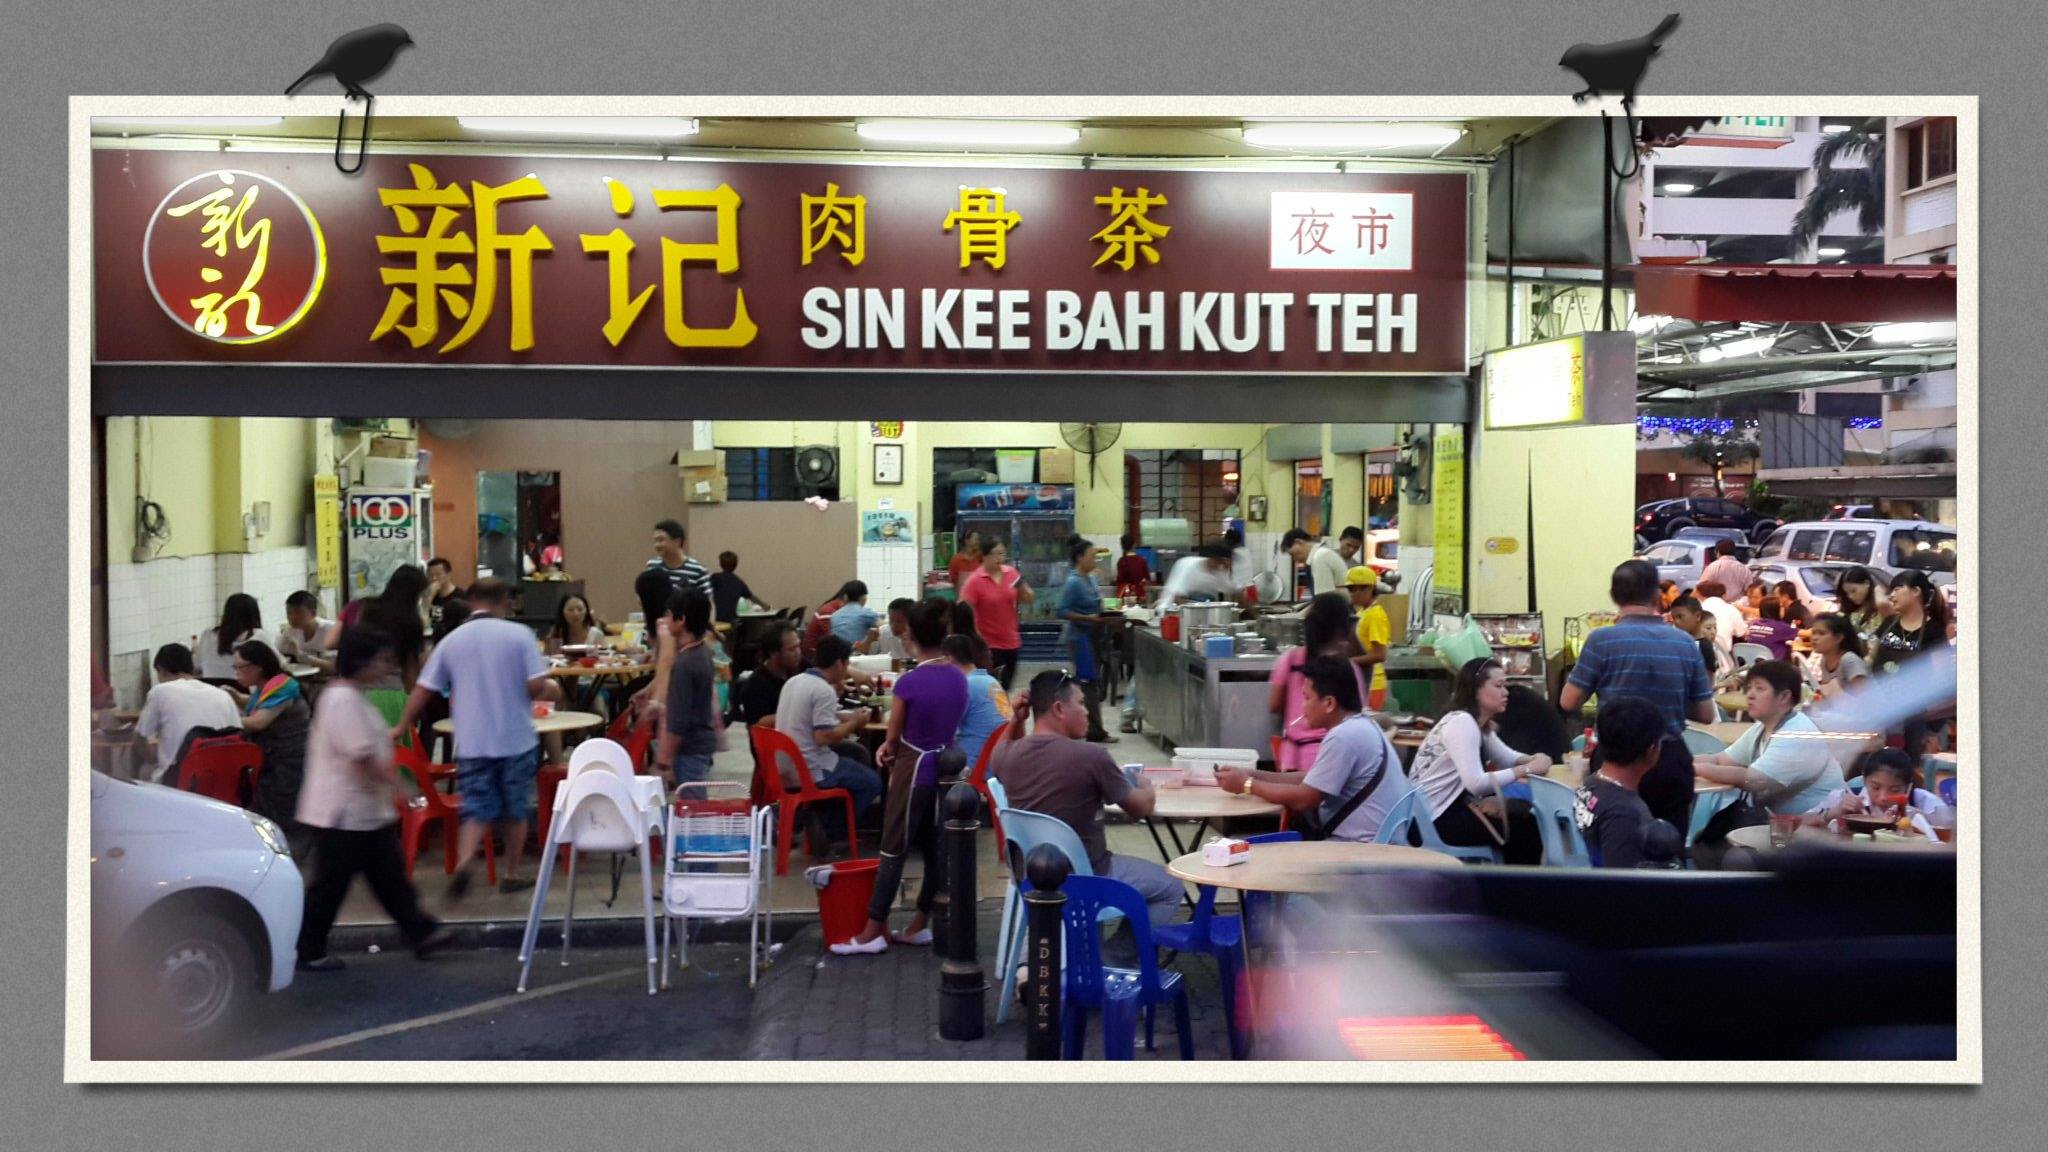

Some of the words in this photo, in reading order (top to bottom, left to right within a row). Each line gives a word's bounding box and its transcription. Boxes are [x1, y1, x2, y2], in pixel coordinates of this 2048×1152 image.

[801, 182, 1171, 271] 肉骨茶
[1290, 207, 1395, 255] 夜市
[370, 163, 758, 352] 新记
[801, 286, 905, 350] SIN
[921, 288, 1031, 350] KEE
[1045, 290, 1165, 351] BAH
[1179, 292, 1295, 353] KUT
[1307, 293, 1418, 353] TEH
[352, 497, 409, 526] 100
[353, 527, 408, 539] PLUS
